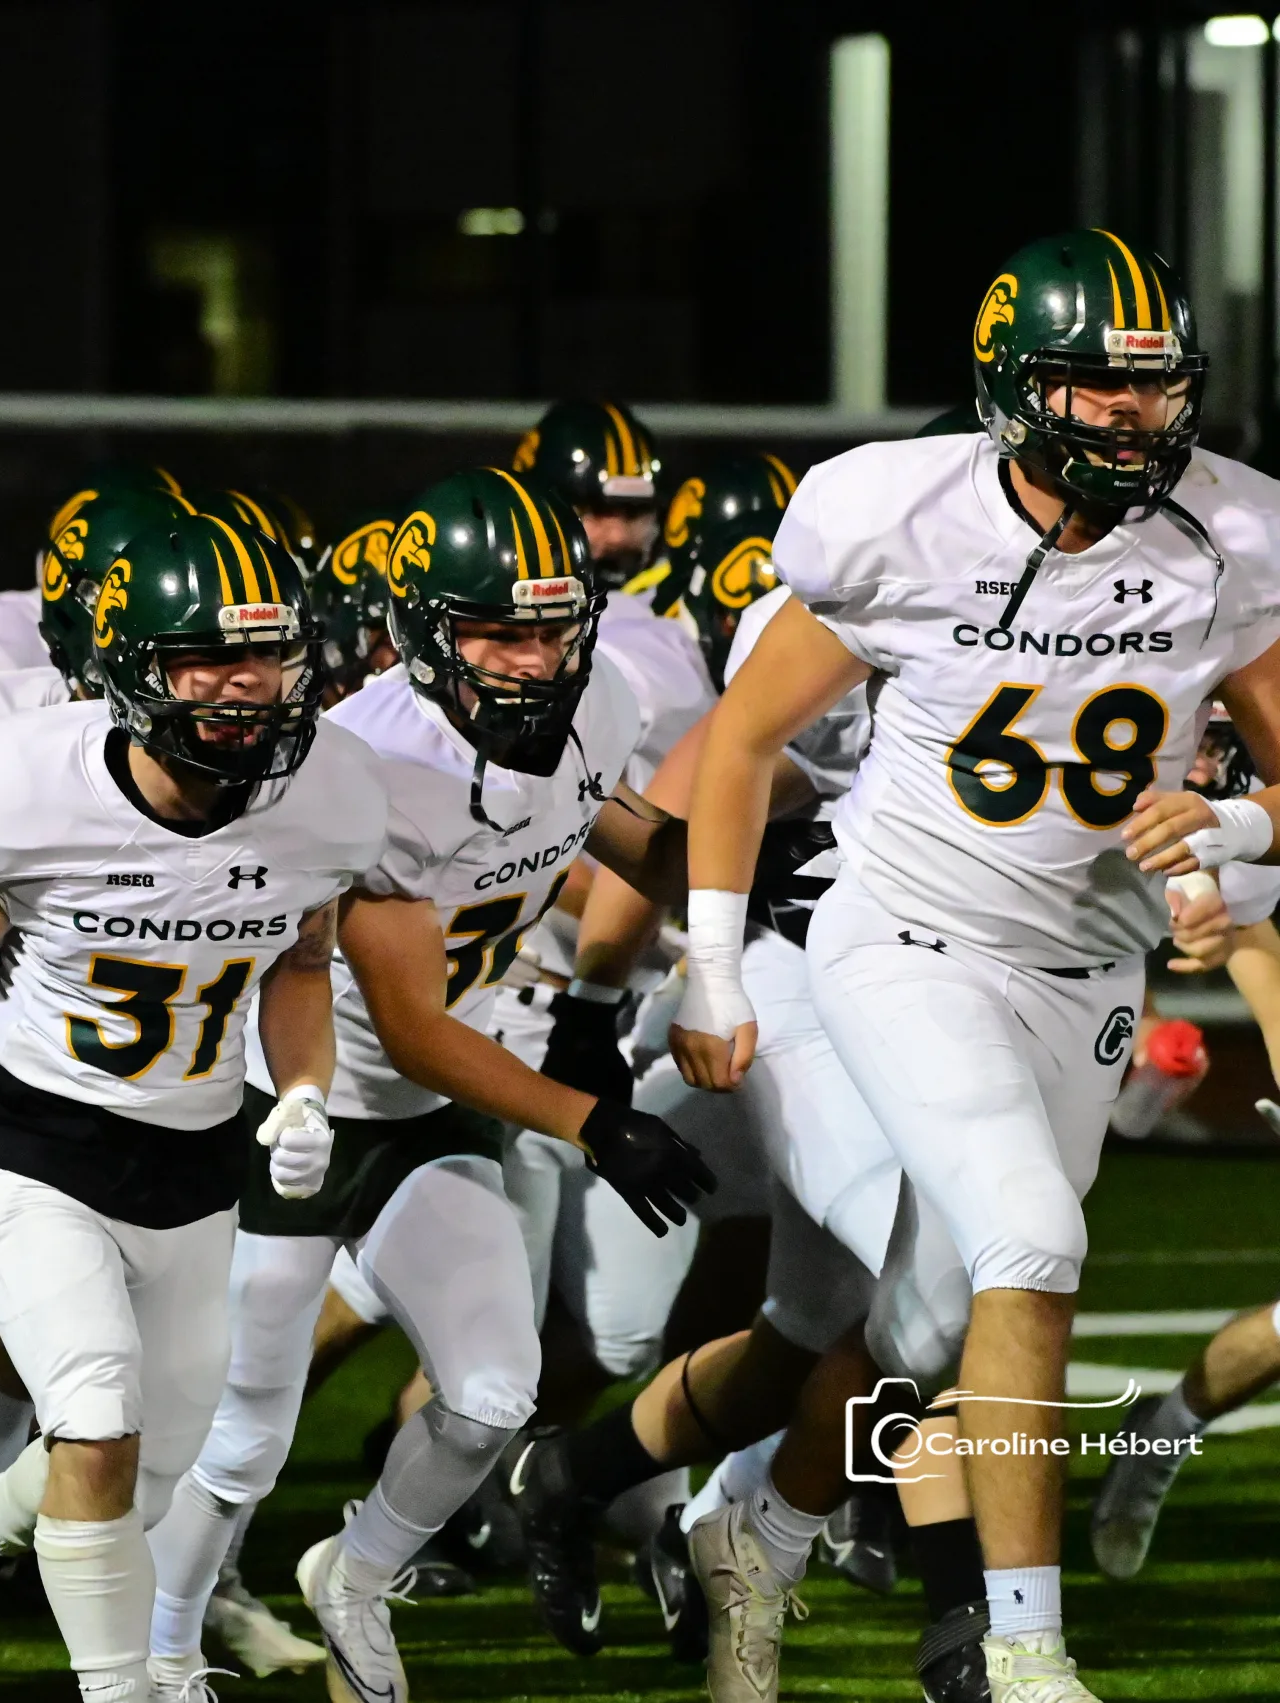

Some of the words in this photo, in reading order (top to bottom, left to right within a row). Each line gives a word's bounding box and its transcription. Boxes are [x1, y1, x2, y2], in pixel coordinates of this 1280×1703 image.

[1126, 335, 1164, 349] Riddell
[532, 582, 569, 597] Riddell
[239, 607, 279, 621] Riddell
[952, 624, 1173, 657] CONDORS
[944, 681, 1169, 831] 68
[106, 874, 155, 888] RSEQ
[73, 911, 287, 942] CONDORS
[63, 952, 256, 1082] 31
